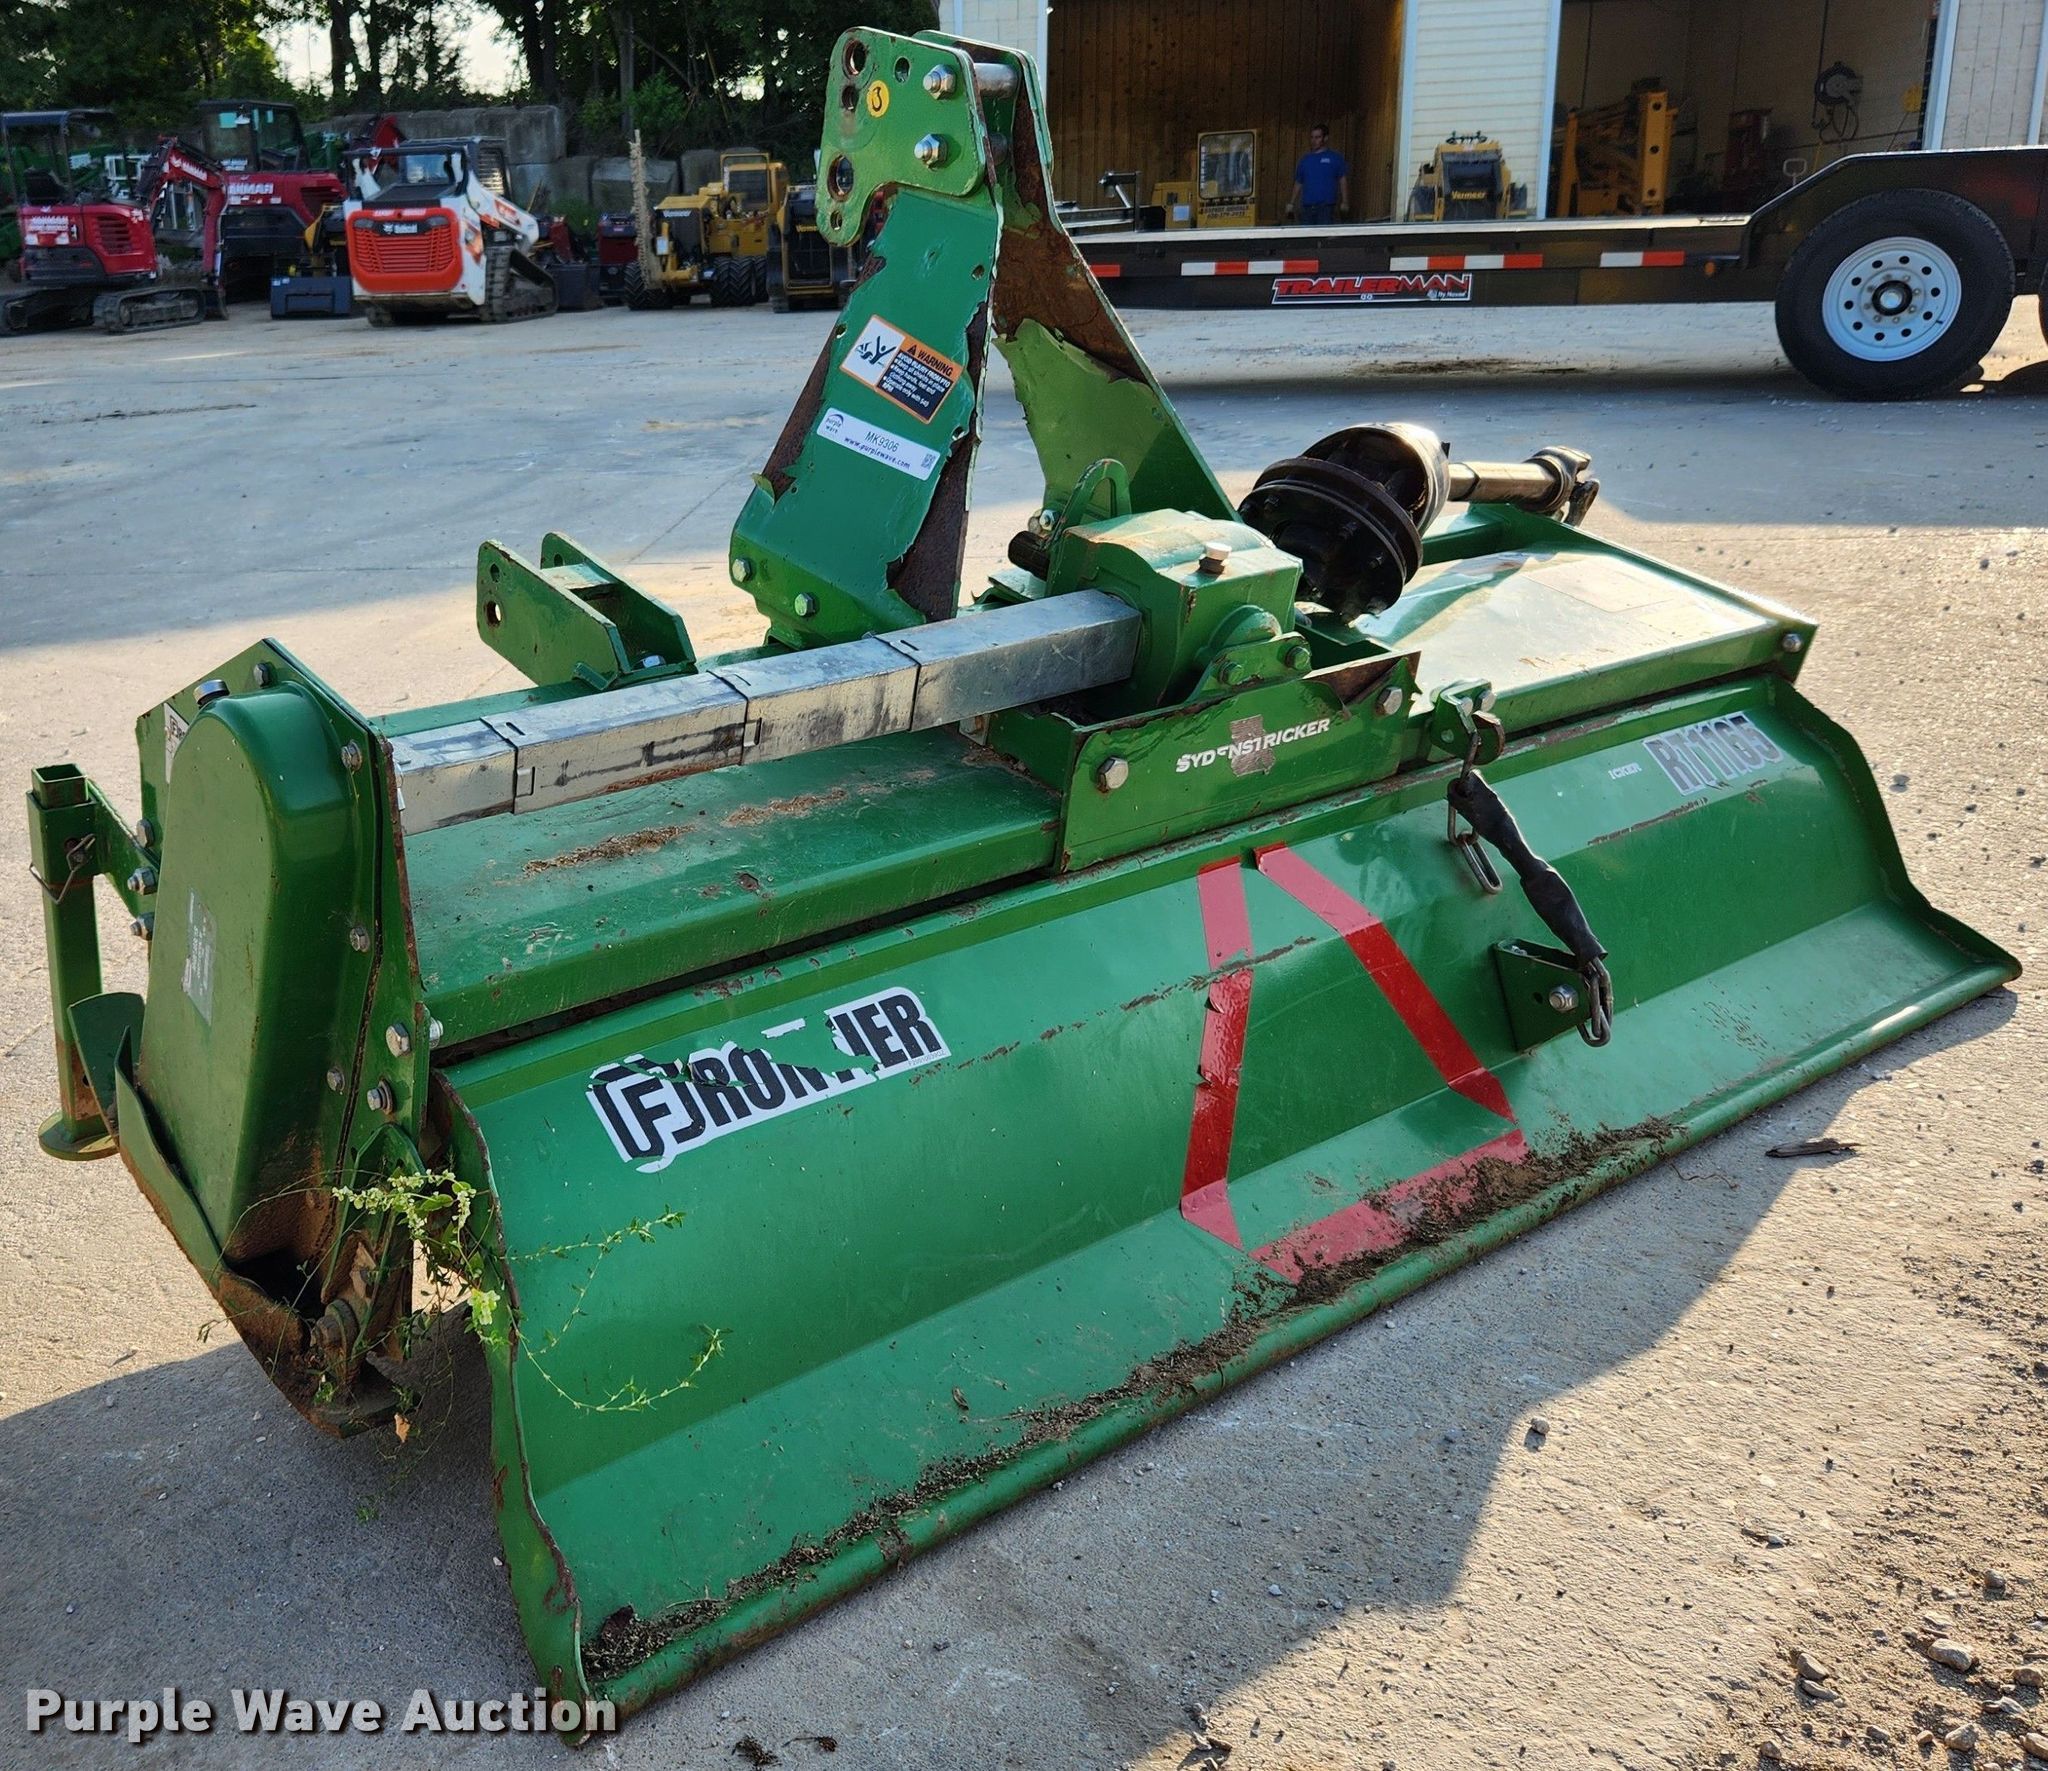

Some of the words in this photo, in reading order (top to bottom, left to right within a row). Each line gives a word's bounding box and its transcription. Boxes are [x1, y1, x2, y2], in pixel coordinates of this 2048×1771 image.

[226, 182, 274, 195] ANMAR
[1451, 190, 1486, 200] Vermeer
[1275, 276, 1468, 296] TRAILERMAN
[917, 350, 954, 377] WARNING
[865, 432, 900, 452] MK9306
[843, 437, 912, 468] www.purplewave.com
[590, 993, 943, 1159] FRONIER
